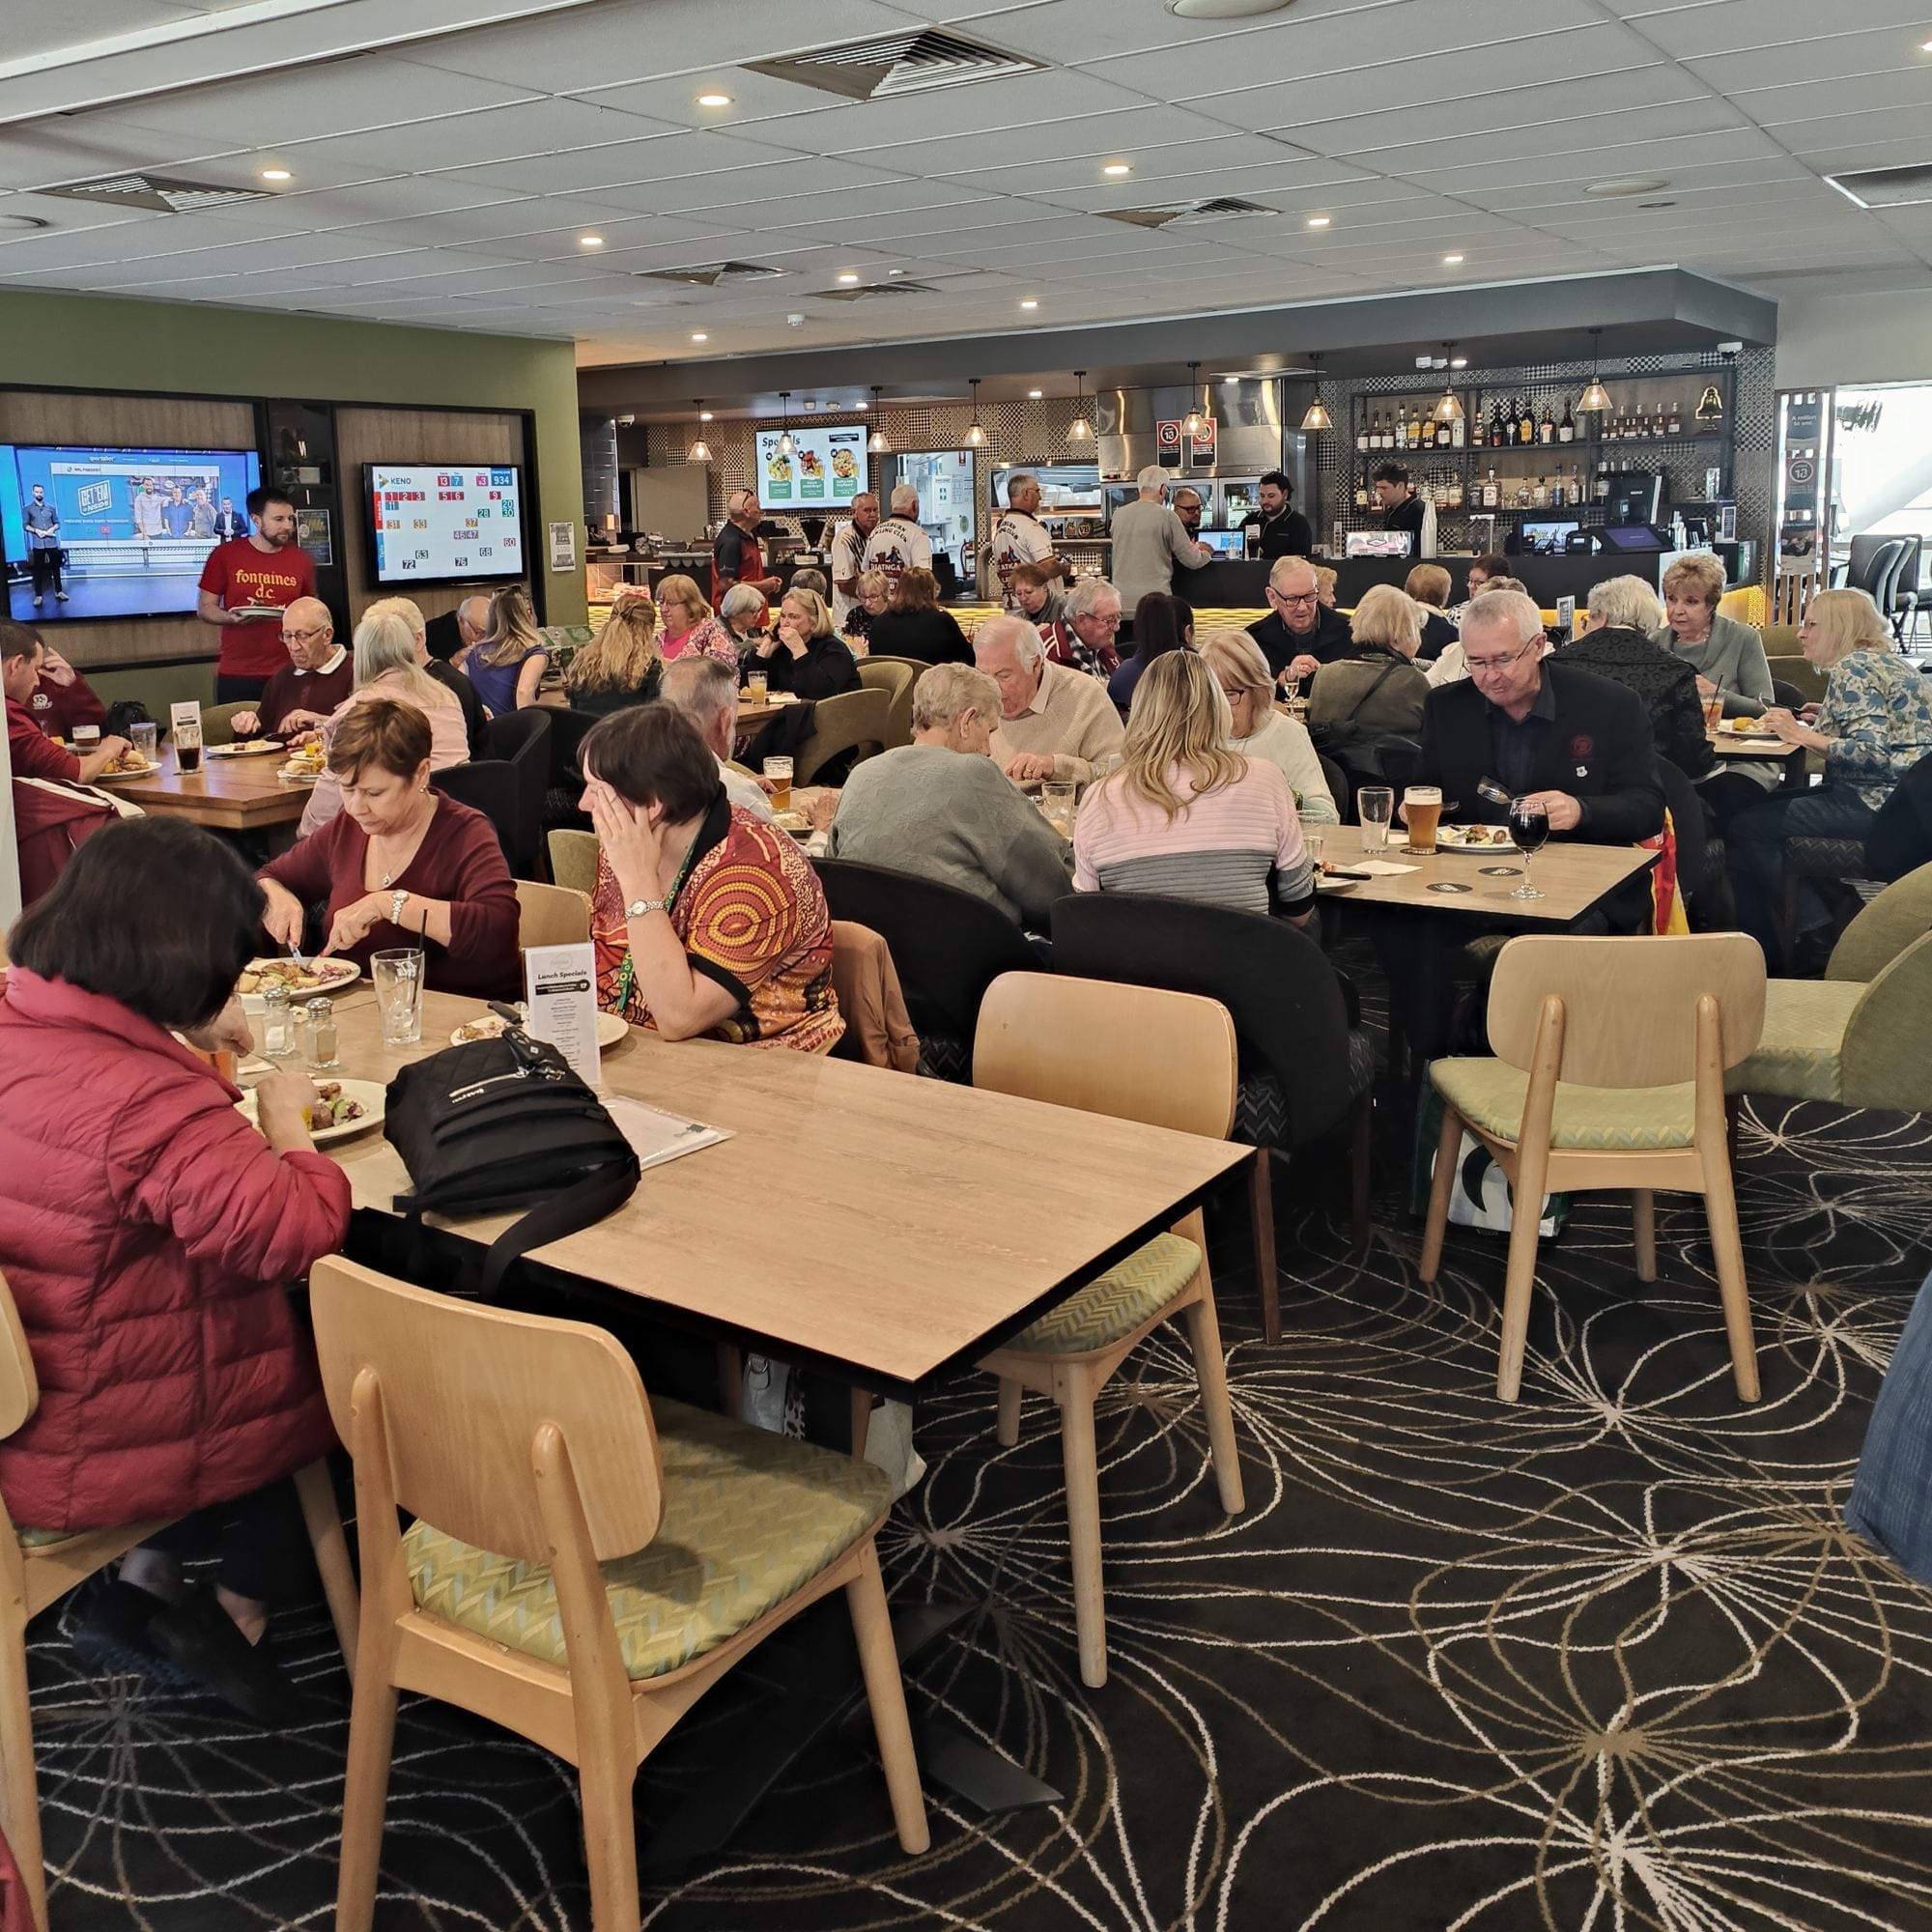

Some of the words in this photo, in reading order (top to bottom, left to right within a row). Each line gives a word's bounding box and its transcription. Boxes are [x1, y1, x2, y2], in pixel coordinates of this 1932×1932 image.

[762, 435, 801, 448] Spels
[494, 476, 509, 485] 934
[81, 487, 94, 507] GET
[1079, 525, 1090, 533] VB
[235, 569, 297, 586] fontaines
[255, 583, 275, 599] d.c.
[559, 969, 587, 979] Specials
